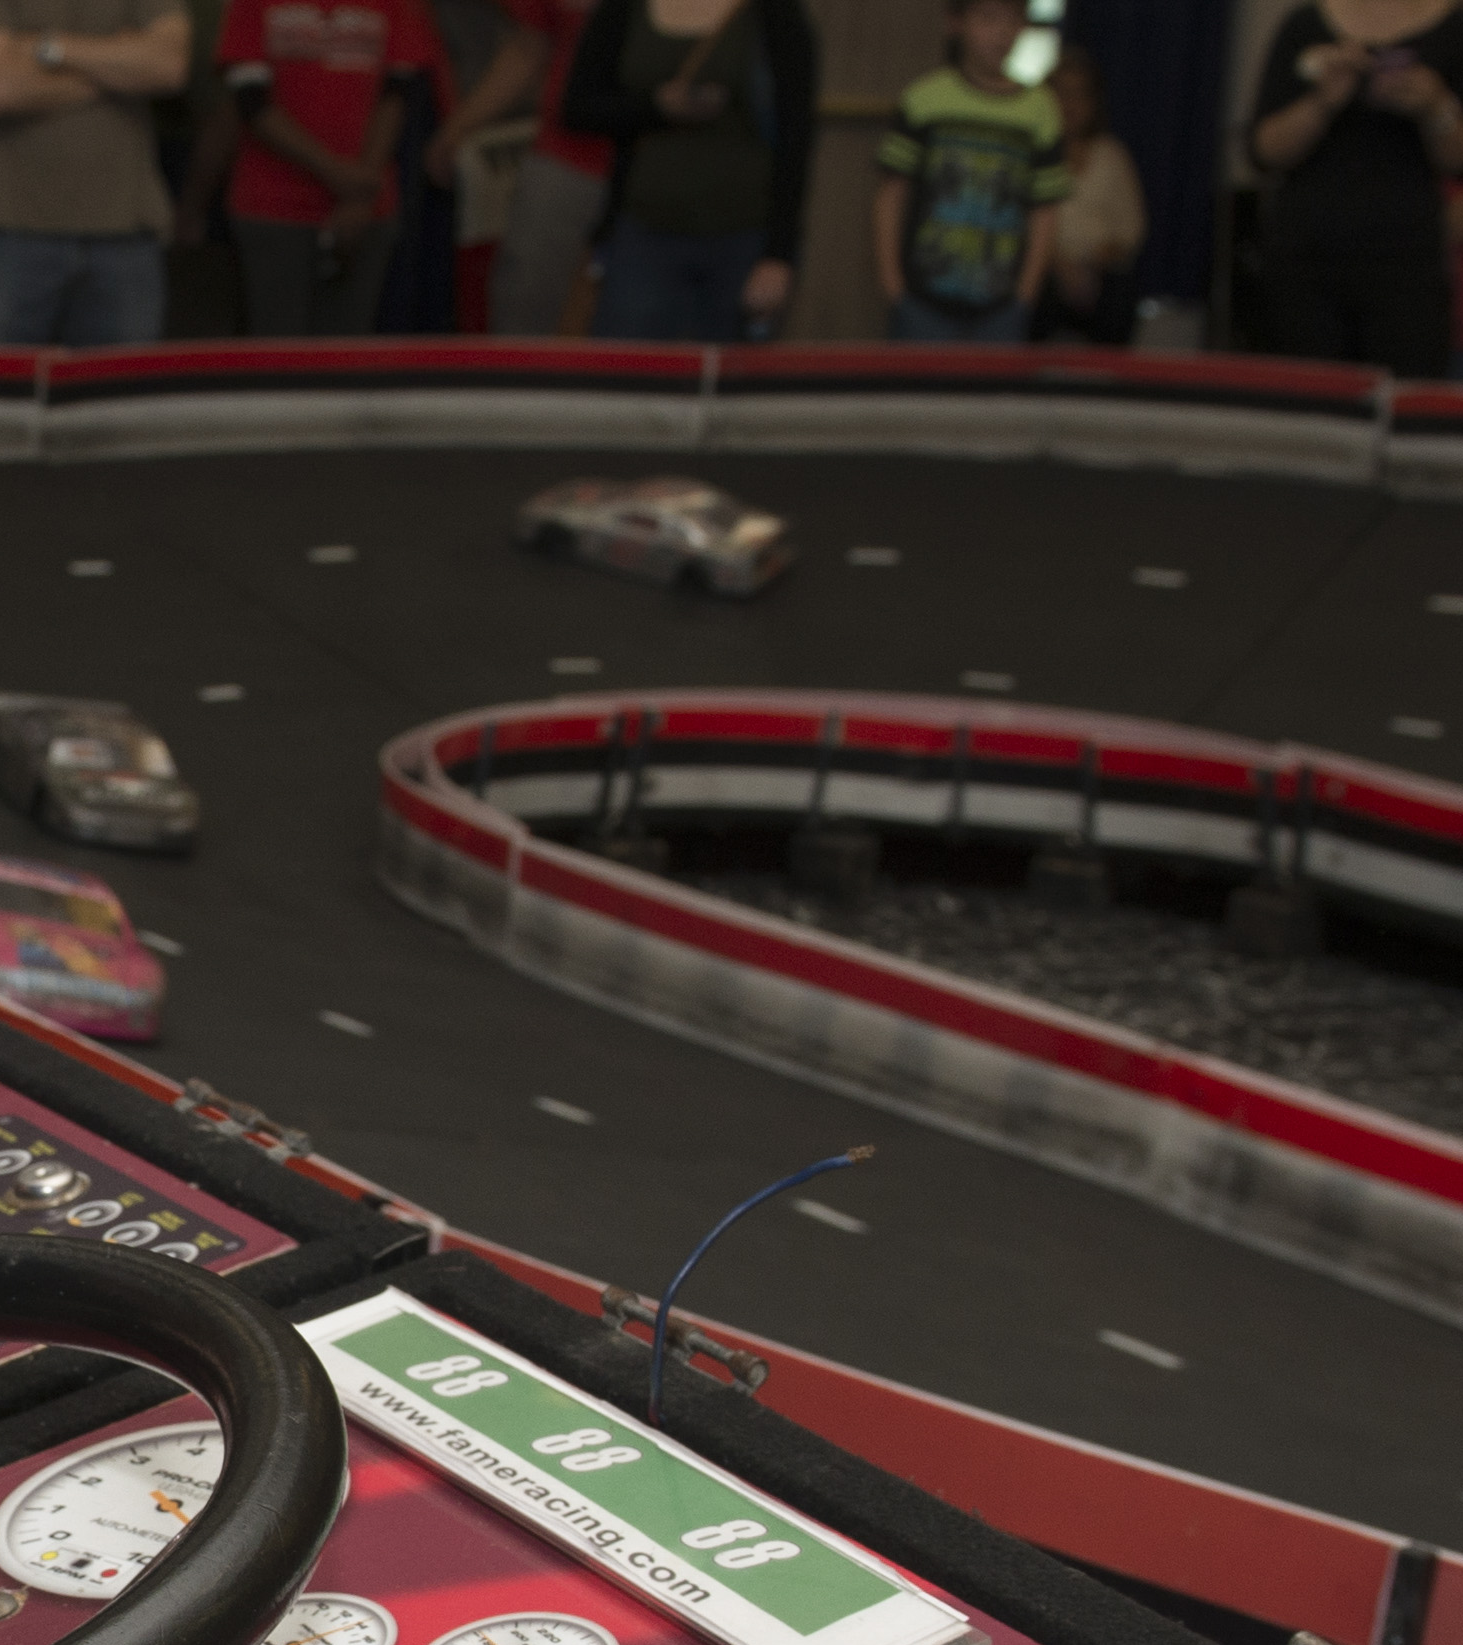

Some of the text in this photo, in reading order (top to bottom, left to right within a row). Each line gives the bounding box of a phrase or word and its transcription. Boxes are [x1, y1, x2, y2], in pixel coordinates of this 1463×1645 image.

[358, 1379, 712, 1605] www.fameracing.com
[405, 1354, 802, 1571] 88 88 88
